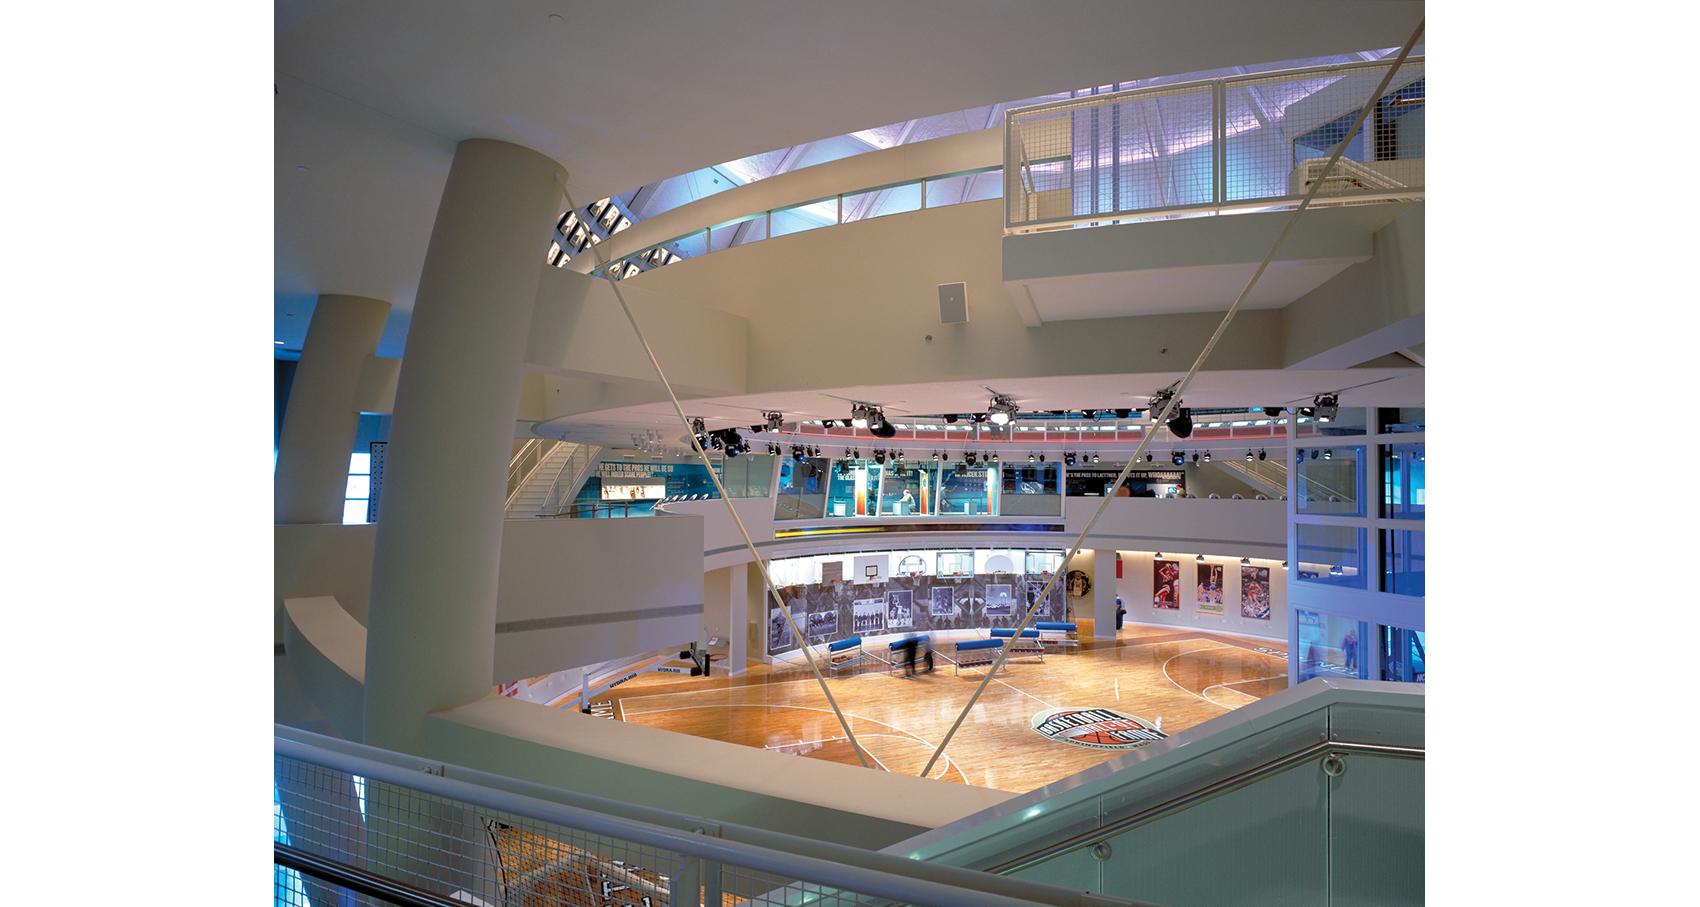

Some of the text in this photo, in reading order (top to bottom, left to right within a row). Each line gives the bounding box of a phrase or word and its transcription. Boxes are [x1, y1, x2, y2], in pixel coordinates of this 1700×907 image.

[623, 464, 632, 472] THE
[1039, 709, 1121, 735] BASKETBALL
[1107, 729, 1165, 741] FAME
